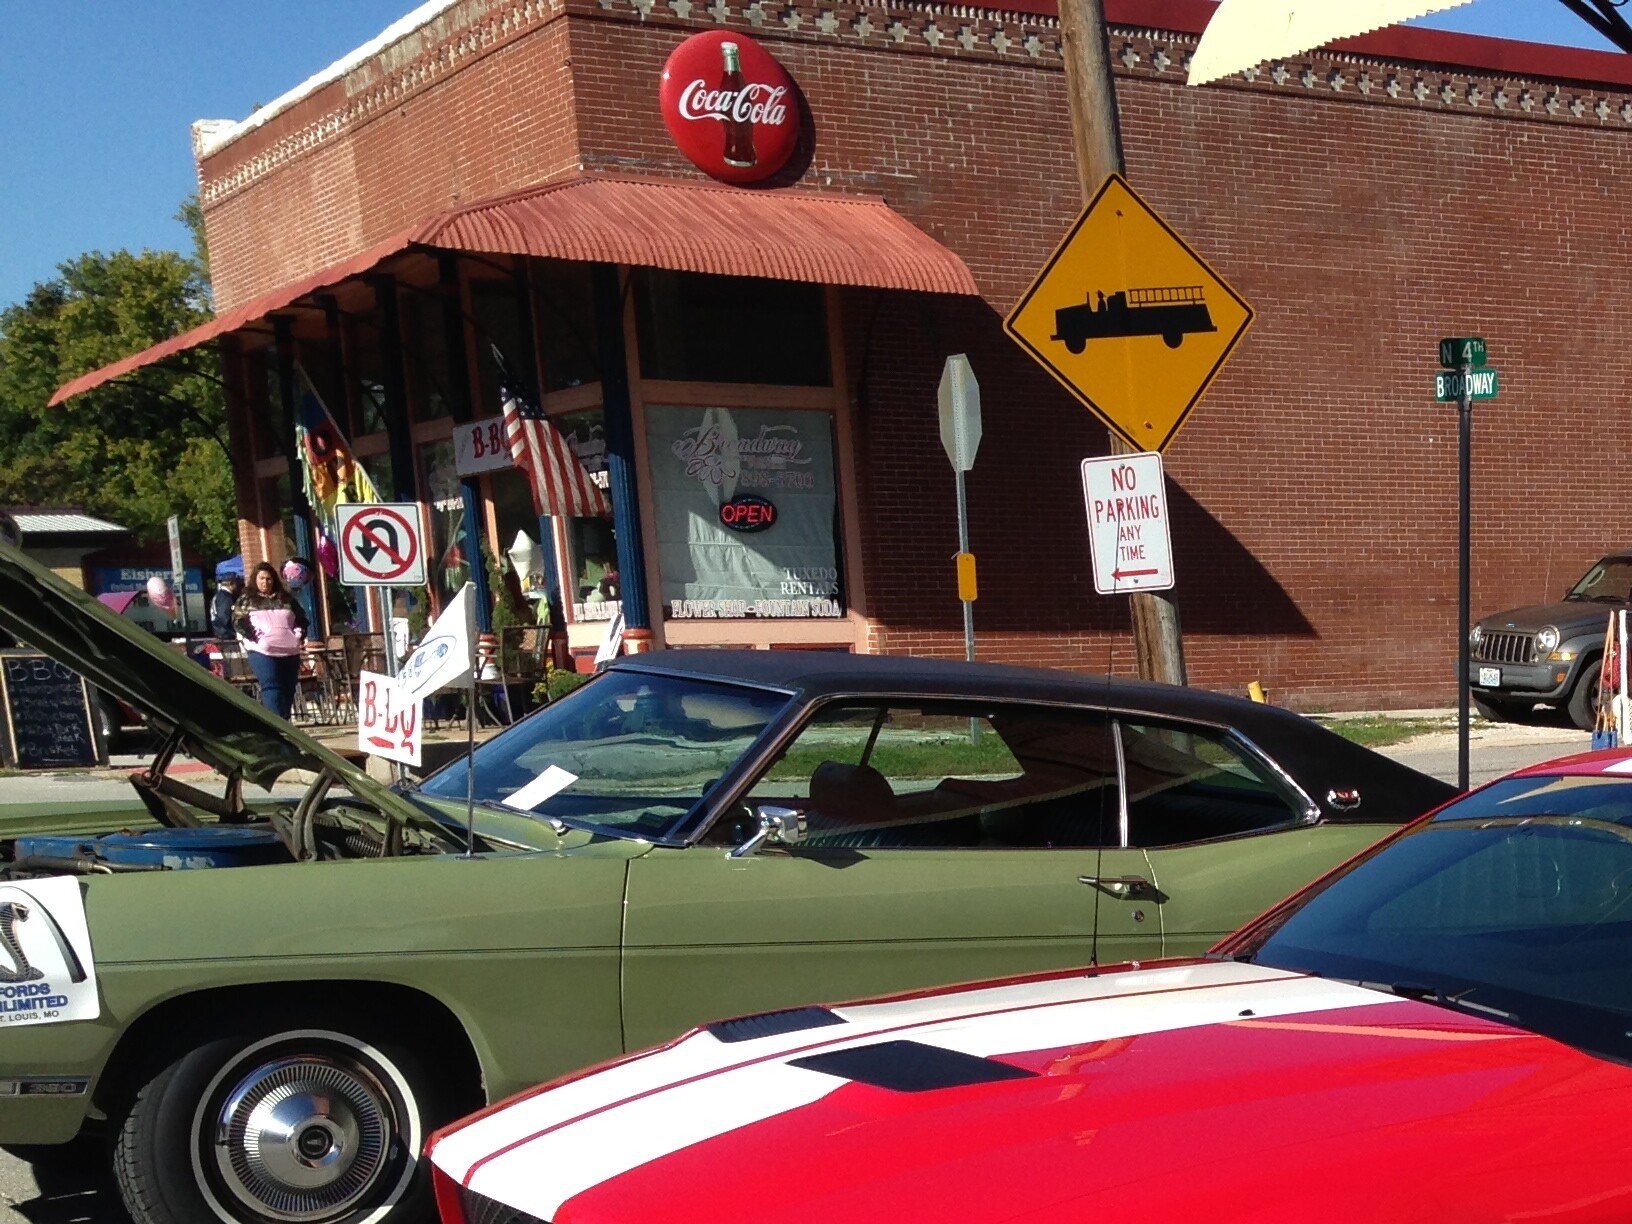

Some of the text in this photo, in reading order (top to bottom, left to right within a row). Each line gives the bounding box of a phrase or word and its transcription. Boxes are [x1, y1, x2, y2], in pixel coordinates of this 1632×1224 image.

[678, 79, 788, 126] Coca-Cola
[1442, 343, 1452, 363] N
[1436, 373, 1495, 398] BROADWAY
[1111, 466, 1136, 492] NO
[721, 505, 773, 523] OPEN
[1094, 494, 1160, 524] PARKING
[1119, 525, 1142, 542] ANY
[1119, 545, 1146, 562] TIME
[784, 567, 837, 580] TUXEDO
[780, 581, 838, 595] RENTALS
[671, 600, 716, 618] FLOWER
[8, 1013, 42, 1022] LOUIS,
[43, 1010, 60, 1018] MO
